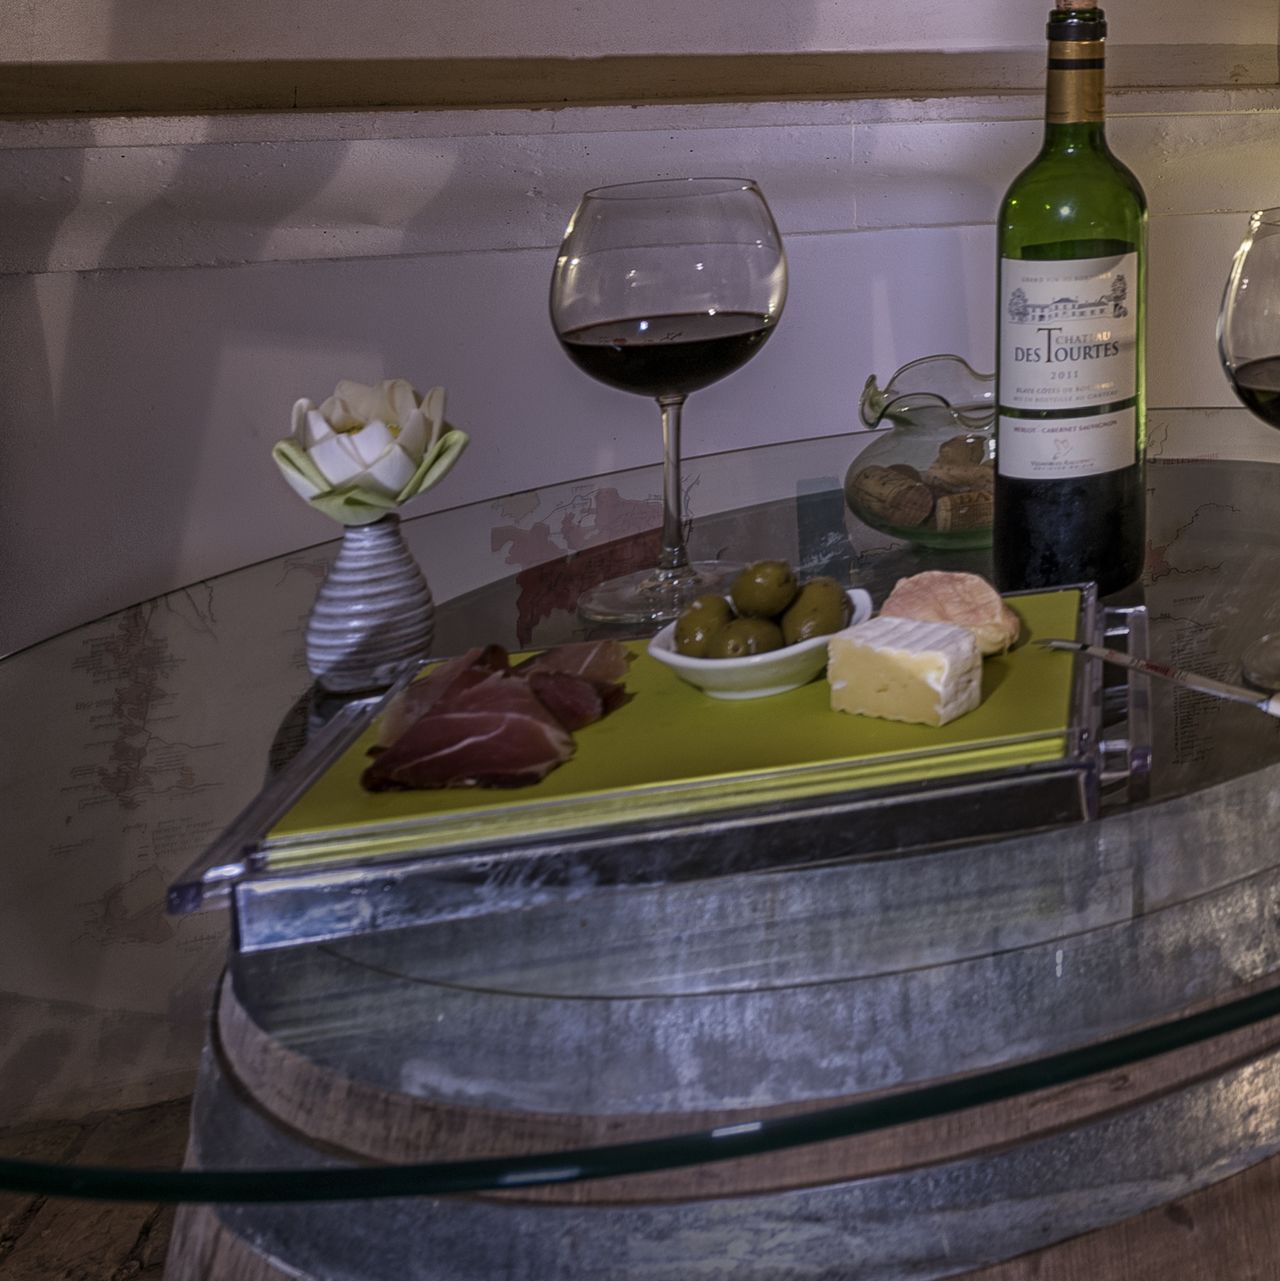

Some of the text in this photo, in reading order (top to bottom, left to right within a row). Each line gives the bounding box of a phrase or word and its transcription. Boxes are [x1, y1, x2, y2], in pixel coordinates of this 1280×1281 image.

[1014, 327, 1120, 363] DES TOURTES
[1050, 370, 1079, 380] 2011
